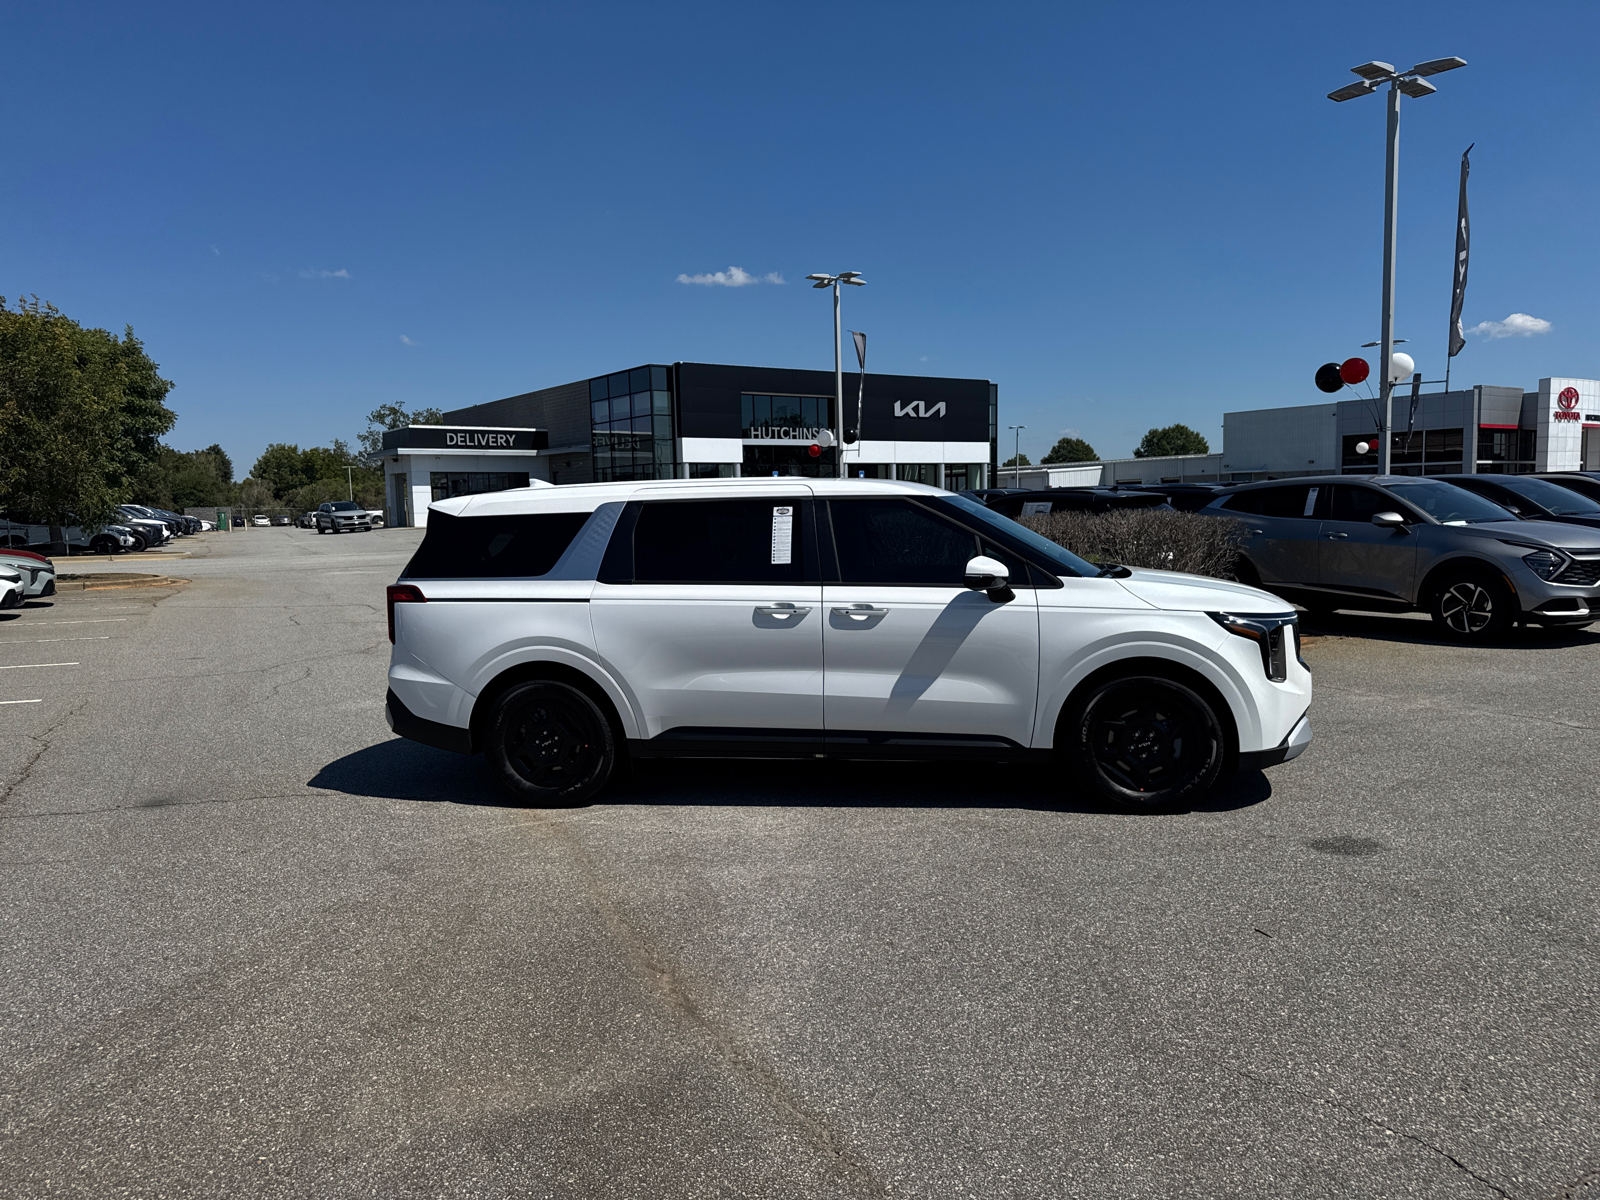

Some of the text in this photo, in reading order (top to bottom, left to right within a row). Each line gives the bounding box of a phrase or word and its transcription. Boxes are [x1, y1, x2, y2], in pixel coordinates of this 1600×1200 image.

[894, 400, 946, 418] KIA
[1554, 411, 1581, 421] TOYOTA
[446, 432, 516, 447] DELIVERY
[750, 426, 837, 440] HUTCHINSN
